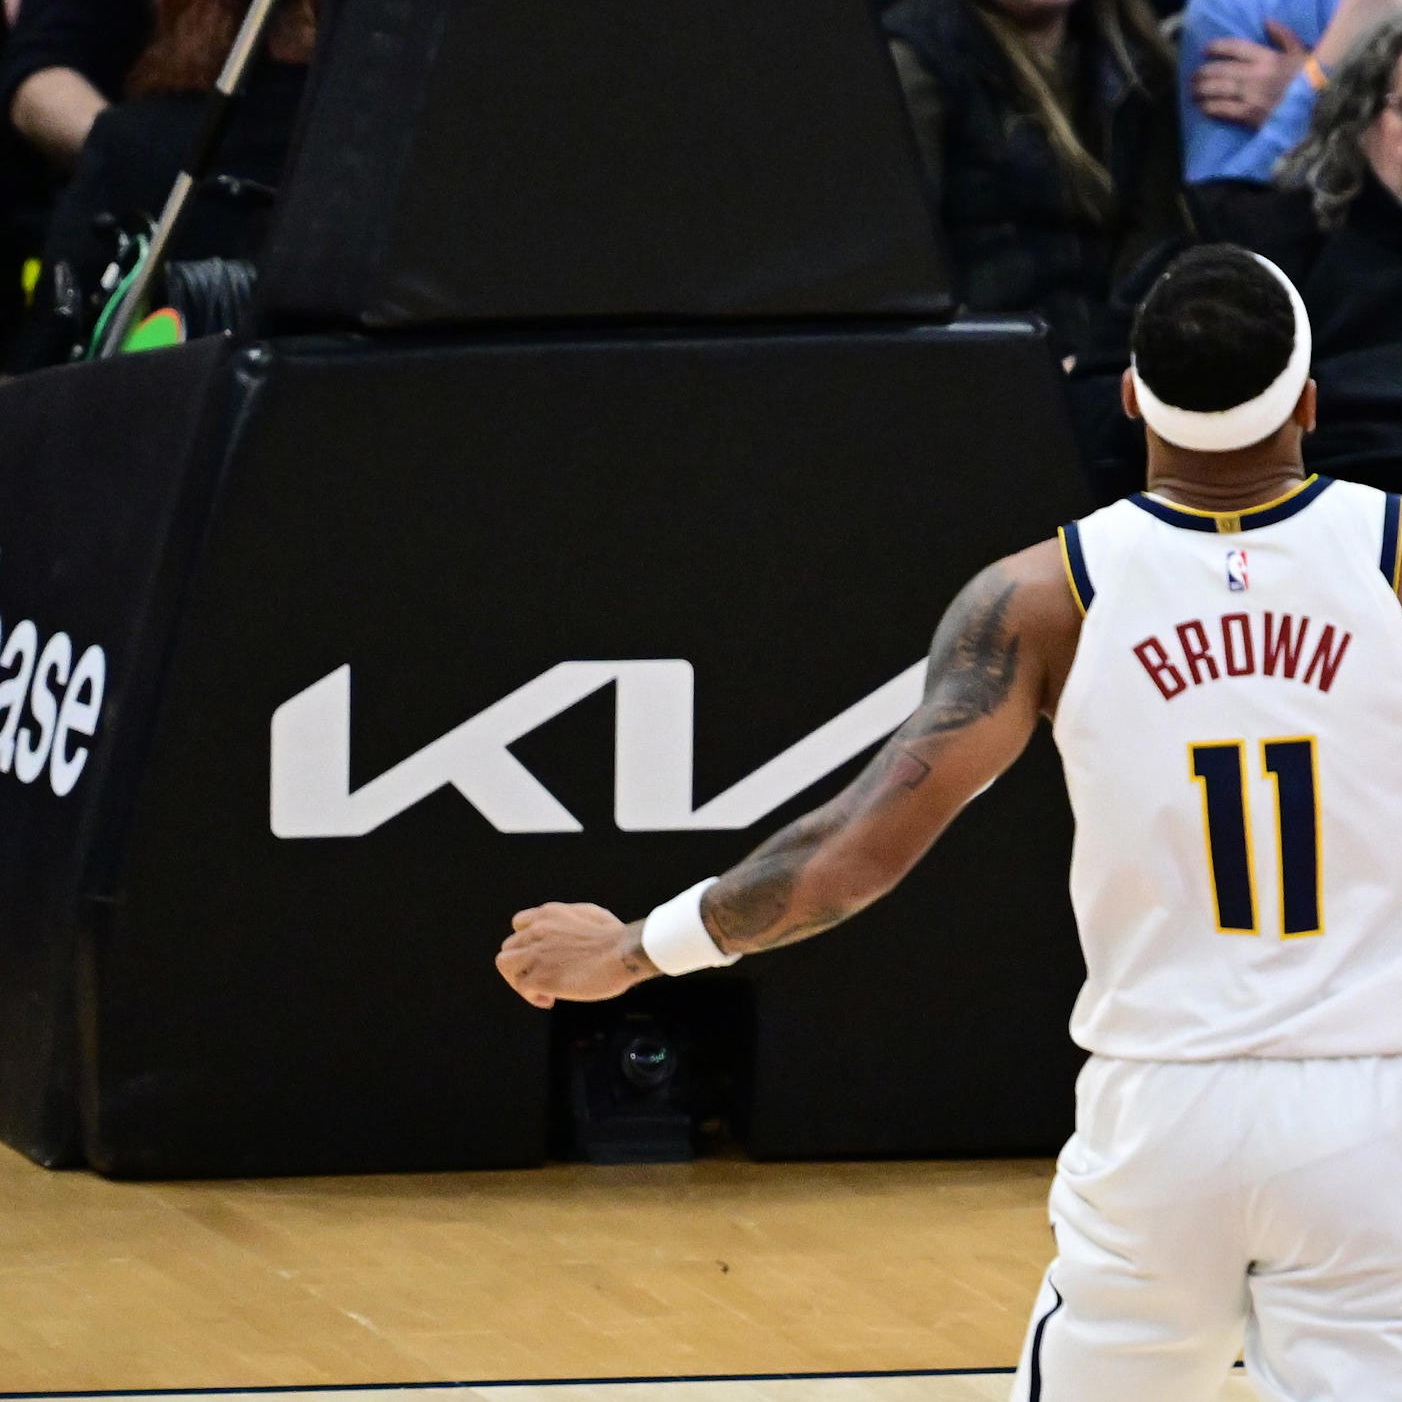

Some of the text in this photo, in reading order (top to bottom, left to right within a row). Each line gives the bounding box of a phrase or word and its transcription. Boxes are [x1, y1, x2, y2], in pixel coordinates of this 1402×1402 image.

[0, 616, 106, 797] ase
[1133, 611, 1353, 701] BROWN
[1187, 734, 1325, 940] 11
